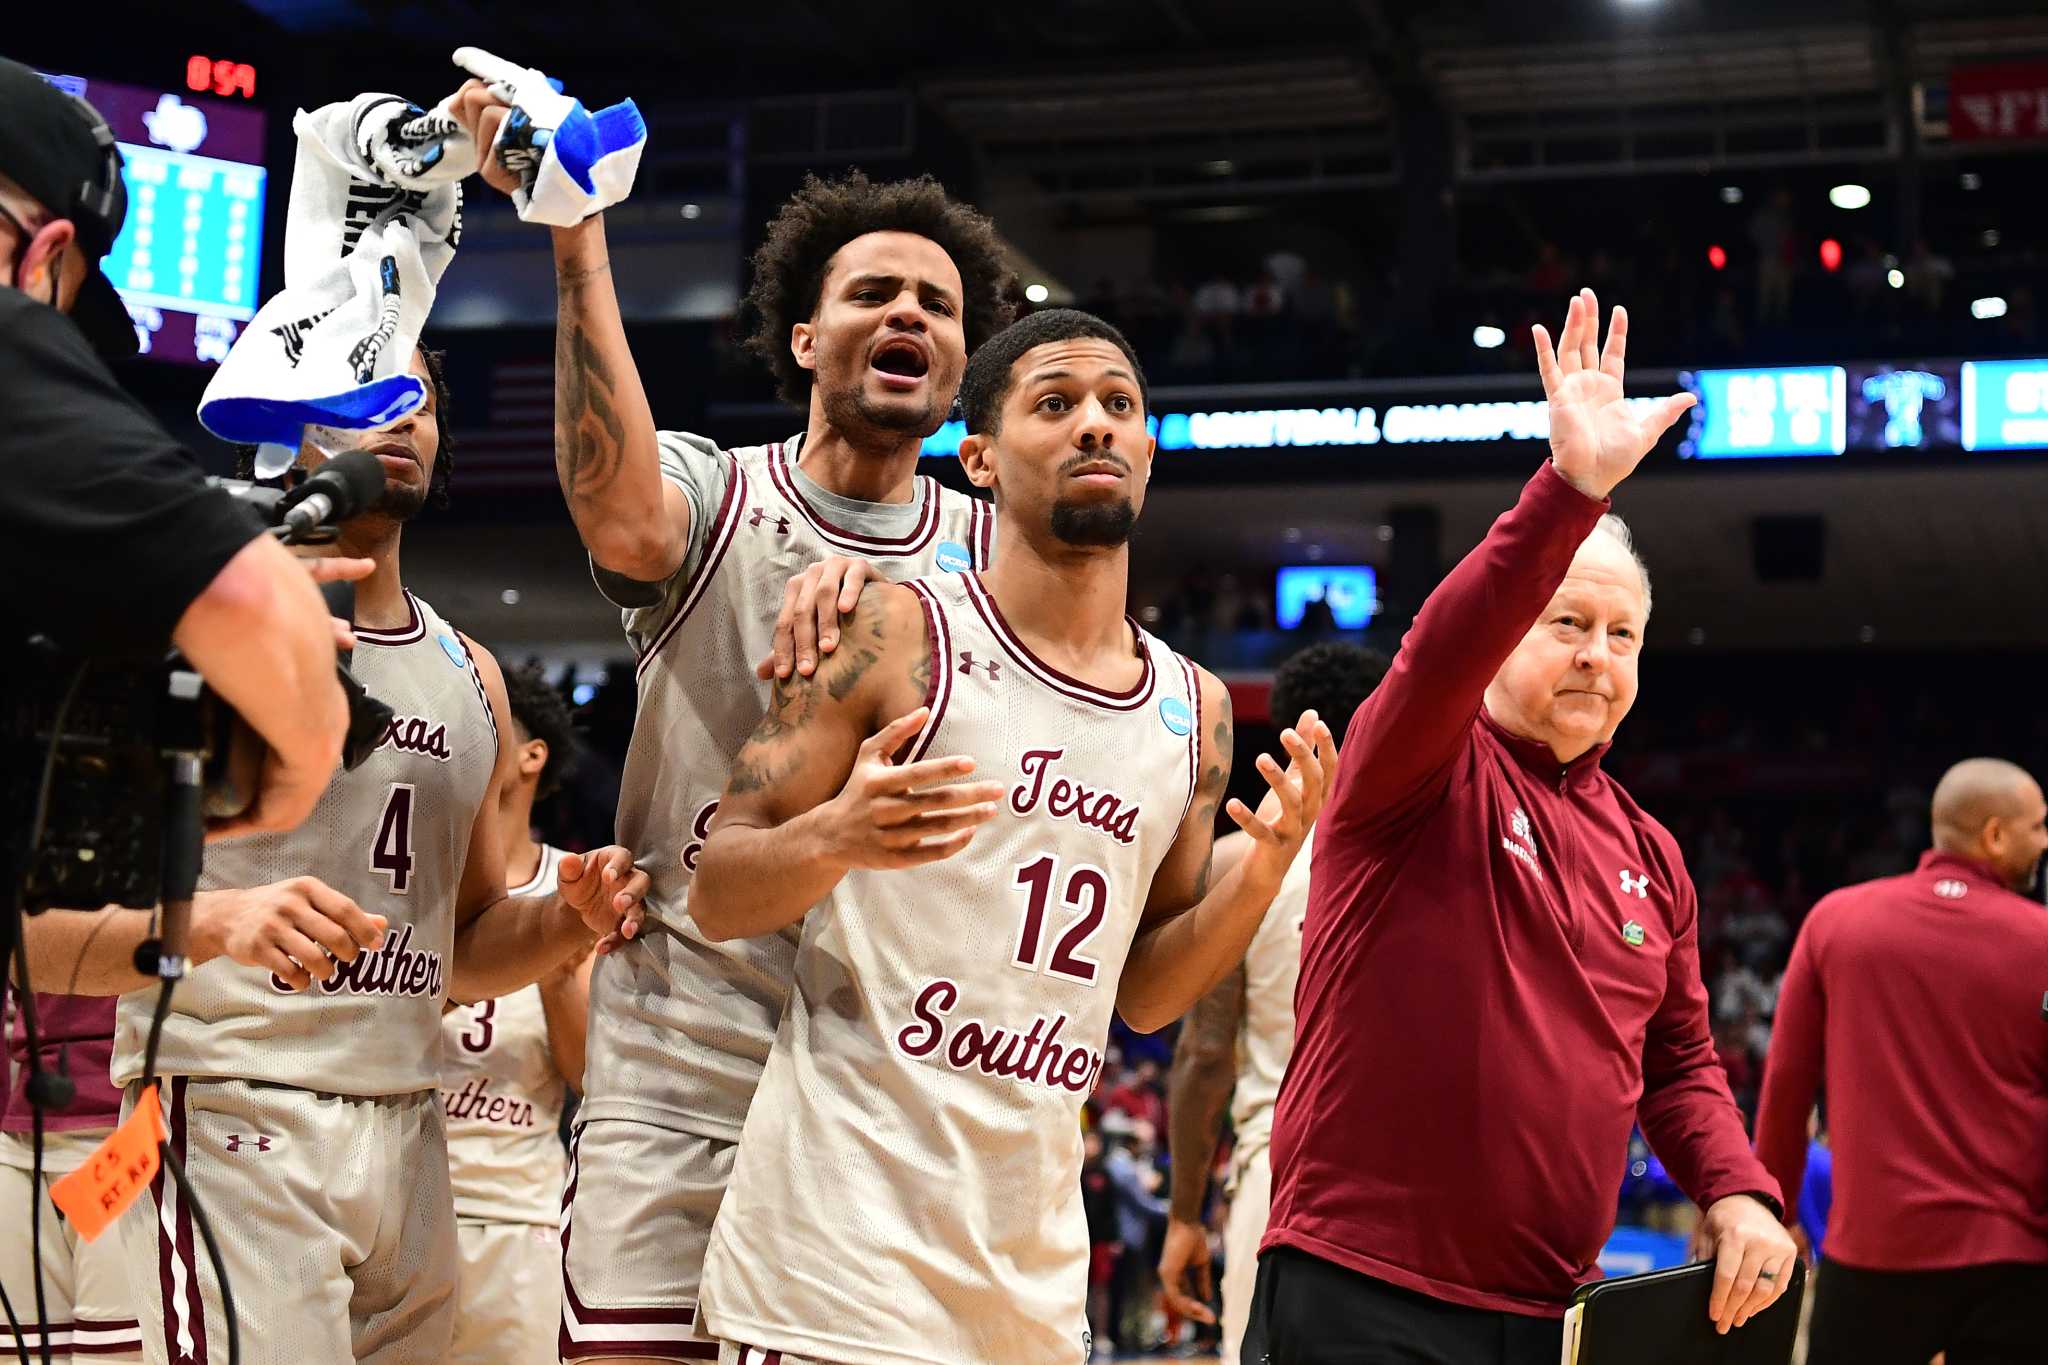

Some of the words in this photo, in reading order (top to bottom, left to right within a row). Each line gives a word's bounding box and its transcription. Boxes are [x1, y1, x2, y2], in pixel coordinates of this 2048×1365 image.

[372, 786, 414, 892] 4
[1010, 748, 1141, 845] Texas
[1014, 854, 1108, 982] 12
[461, 999, 496, 1053] 3
[896, 979, 1103, 1096] Souther
[441, 1078, 535, 1127] uthern
